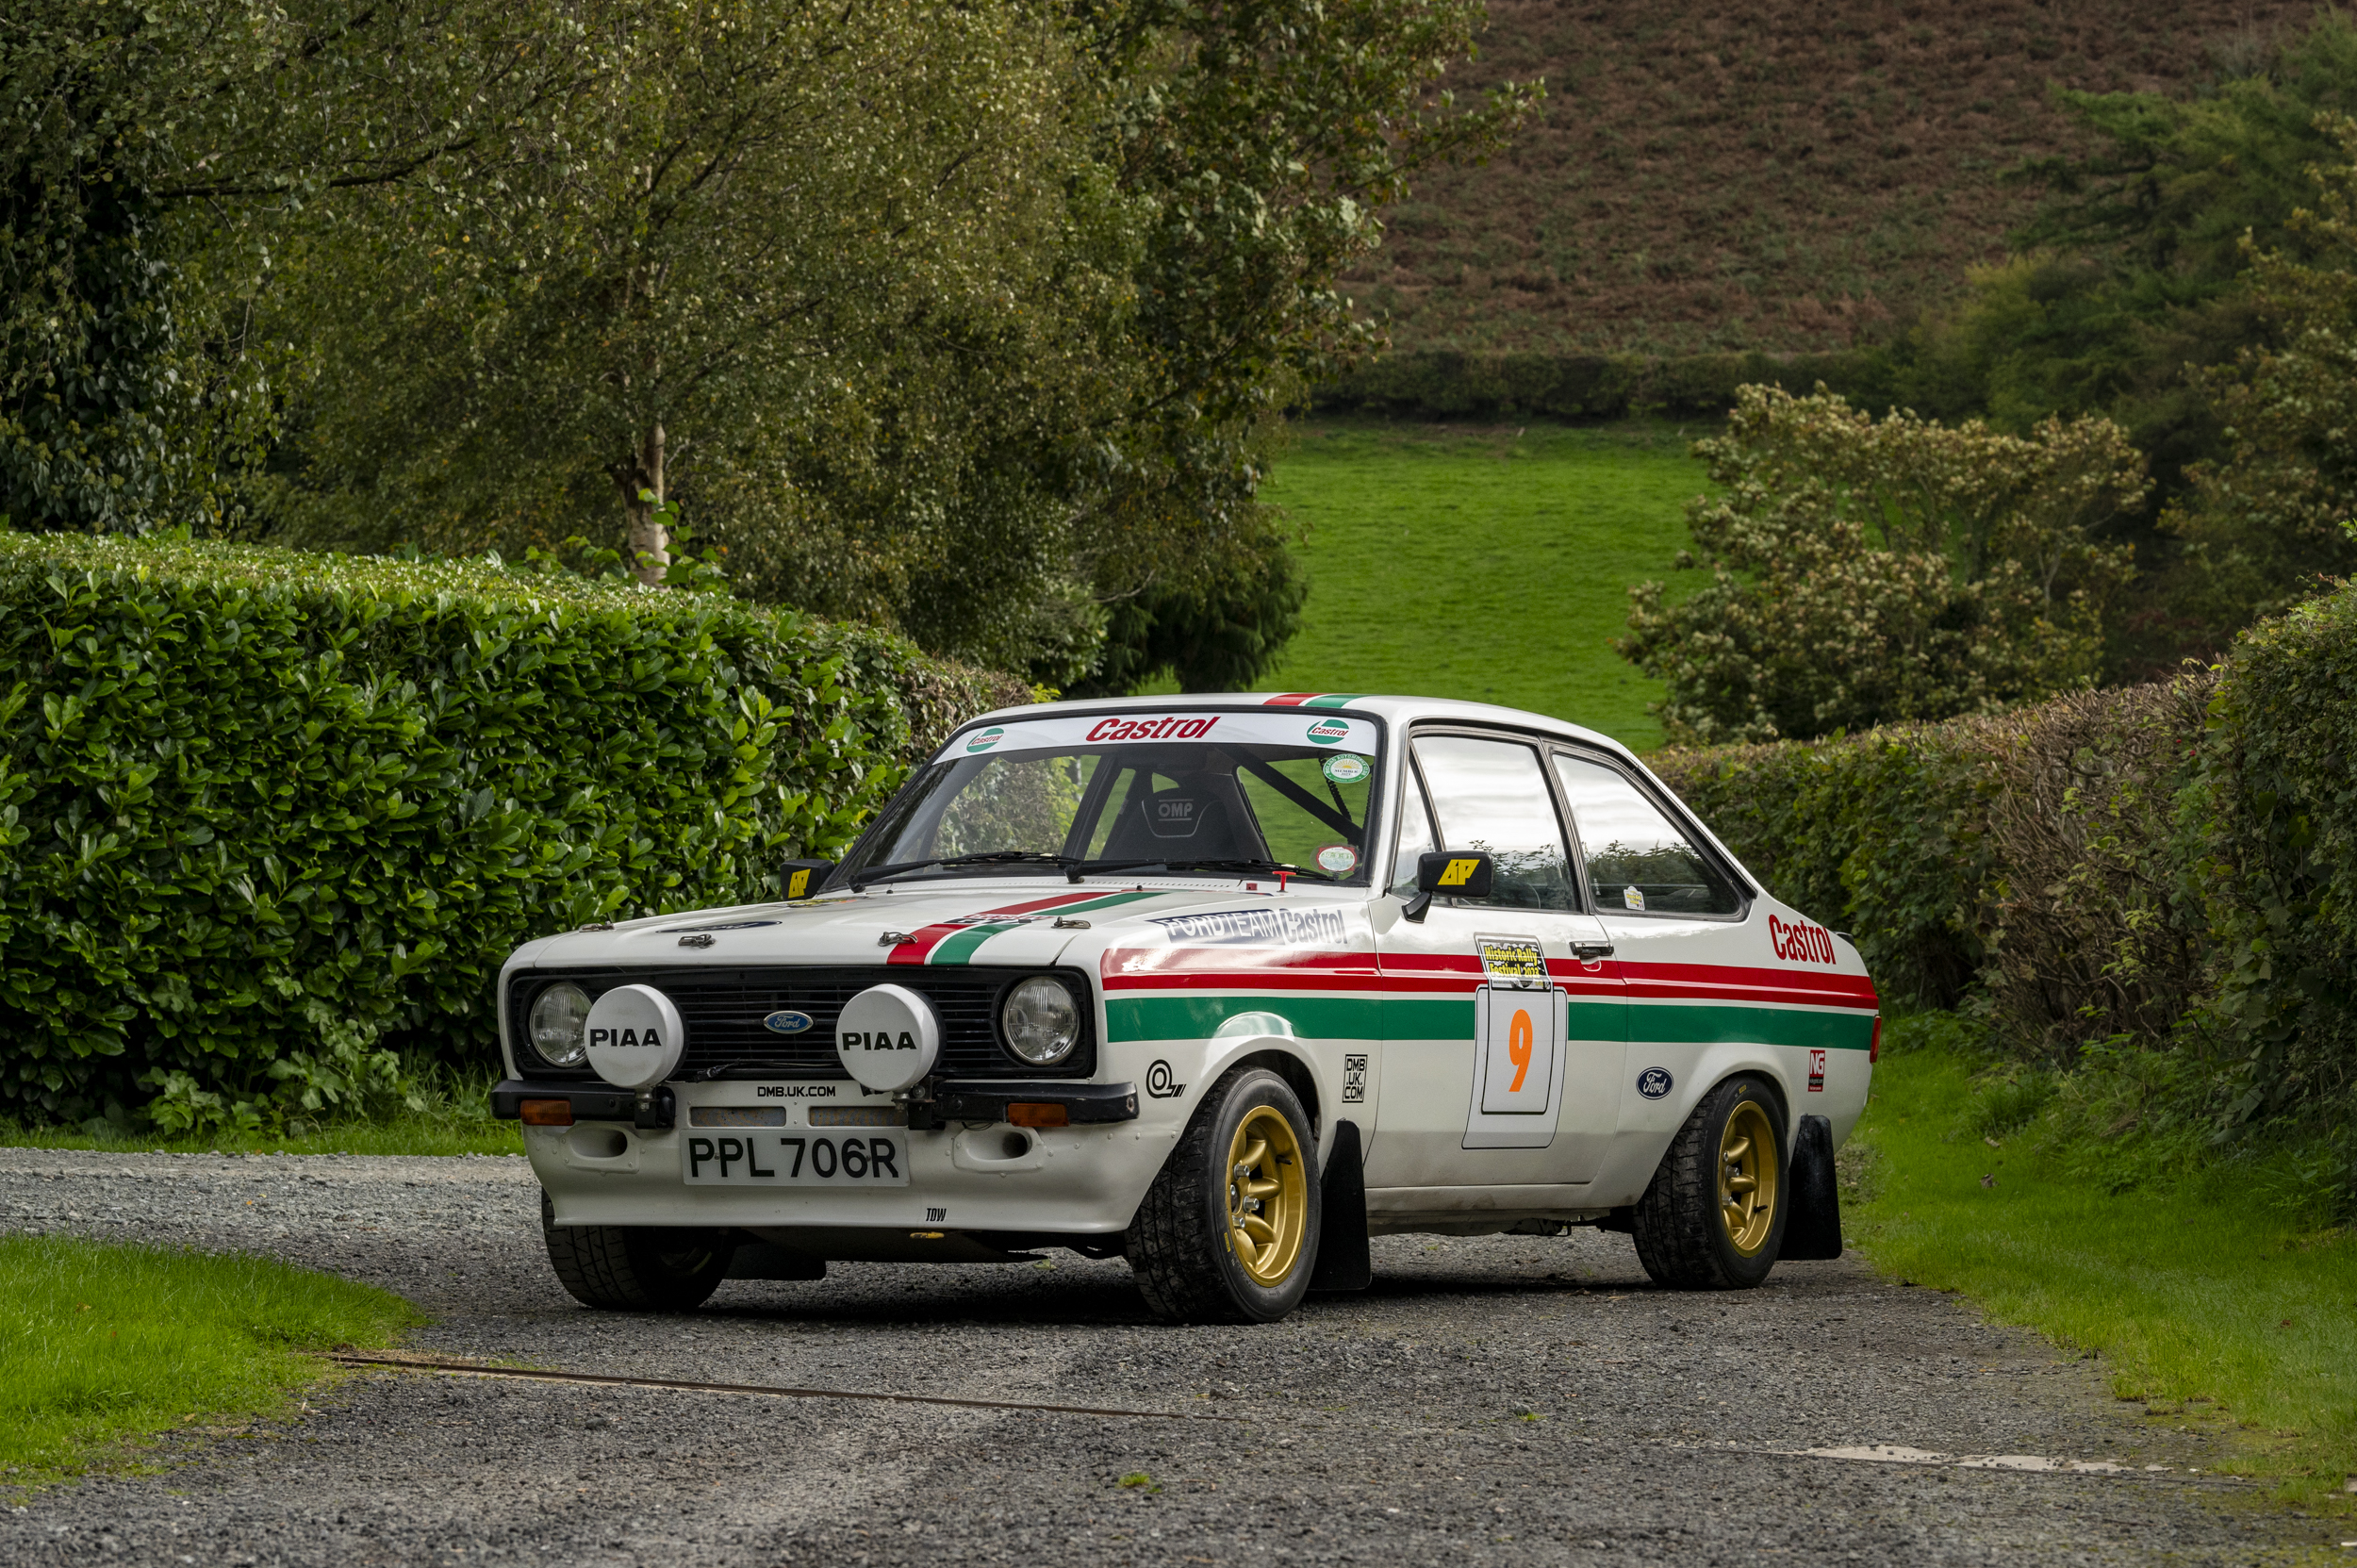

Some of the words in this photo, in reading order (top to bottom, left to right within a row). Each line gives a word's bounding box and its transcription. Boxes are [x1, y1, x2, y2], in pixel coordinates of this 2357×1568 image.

[1086, 717, 1221, 741] Castrol
[1311, 727, 1349, 736] Castrol
[971, 734, 1003, 745] Castrol
[1158, 802, 1193, 817] OMP
[1278, 908, 1347, 944] Castrol
[1769, 914, 1837, 965] Castrol
[1483, 946, 1517, 962] Historic
[1516, 948, 1538, 966] Rally
[1489, 962, 1522, 978] Festival
[1523, 965, 1541, 979] 2023
[774, 1015, 800, 1028] Ford
[590, 1029, 662, 1047] PIAA
[842, 1032, 917, 1050] PIAA
[1508, 1009, 1533, 1092] 9
[1346, 1058, 1365, 1071] DMB
[1809, 1052, 1824, 1075] NG
[1345, 1072, 1362, 1085] .UK.
[1642, 1071, 1668, 1094] Ford
[757, 1086, 836, 1098] DMB.UK.COM
[1344, 1086, 1363, 1099] COM
[688, 1137, 775, 1178] PPL
[780, 1137, 899, 1178] 706R
[926, 1208, 947, 1222] TOW
